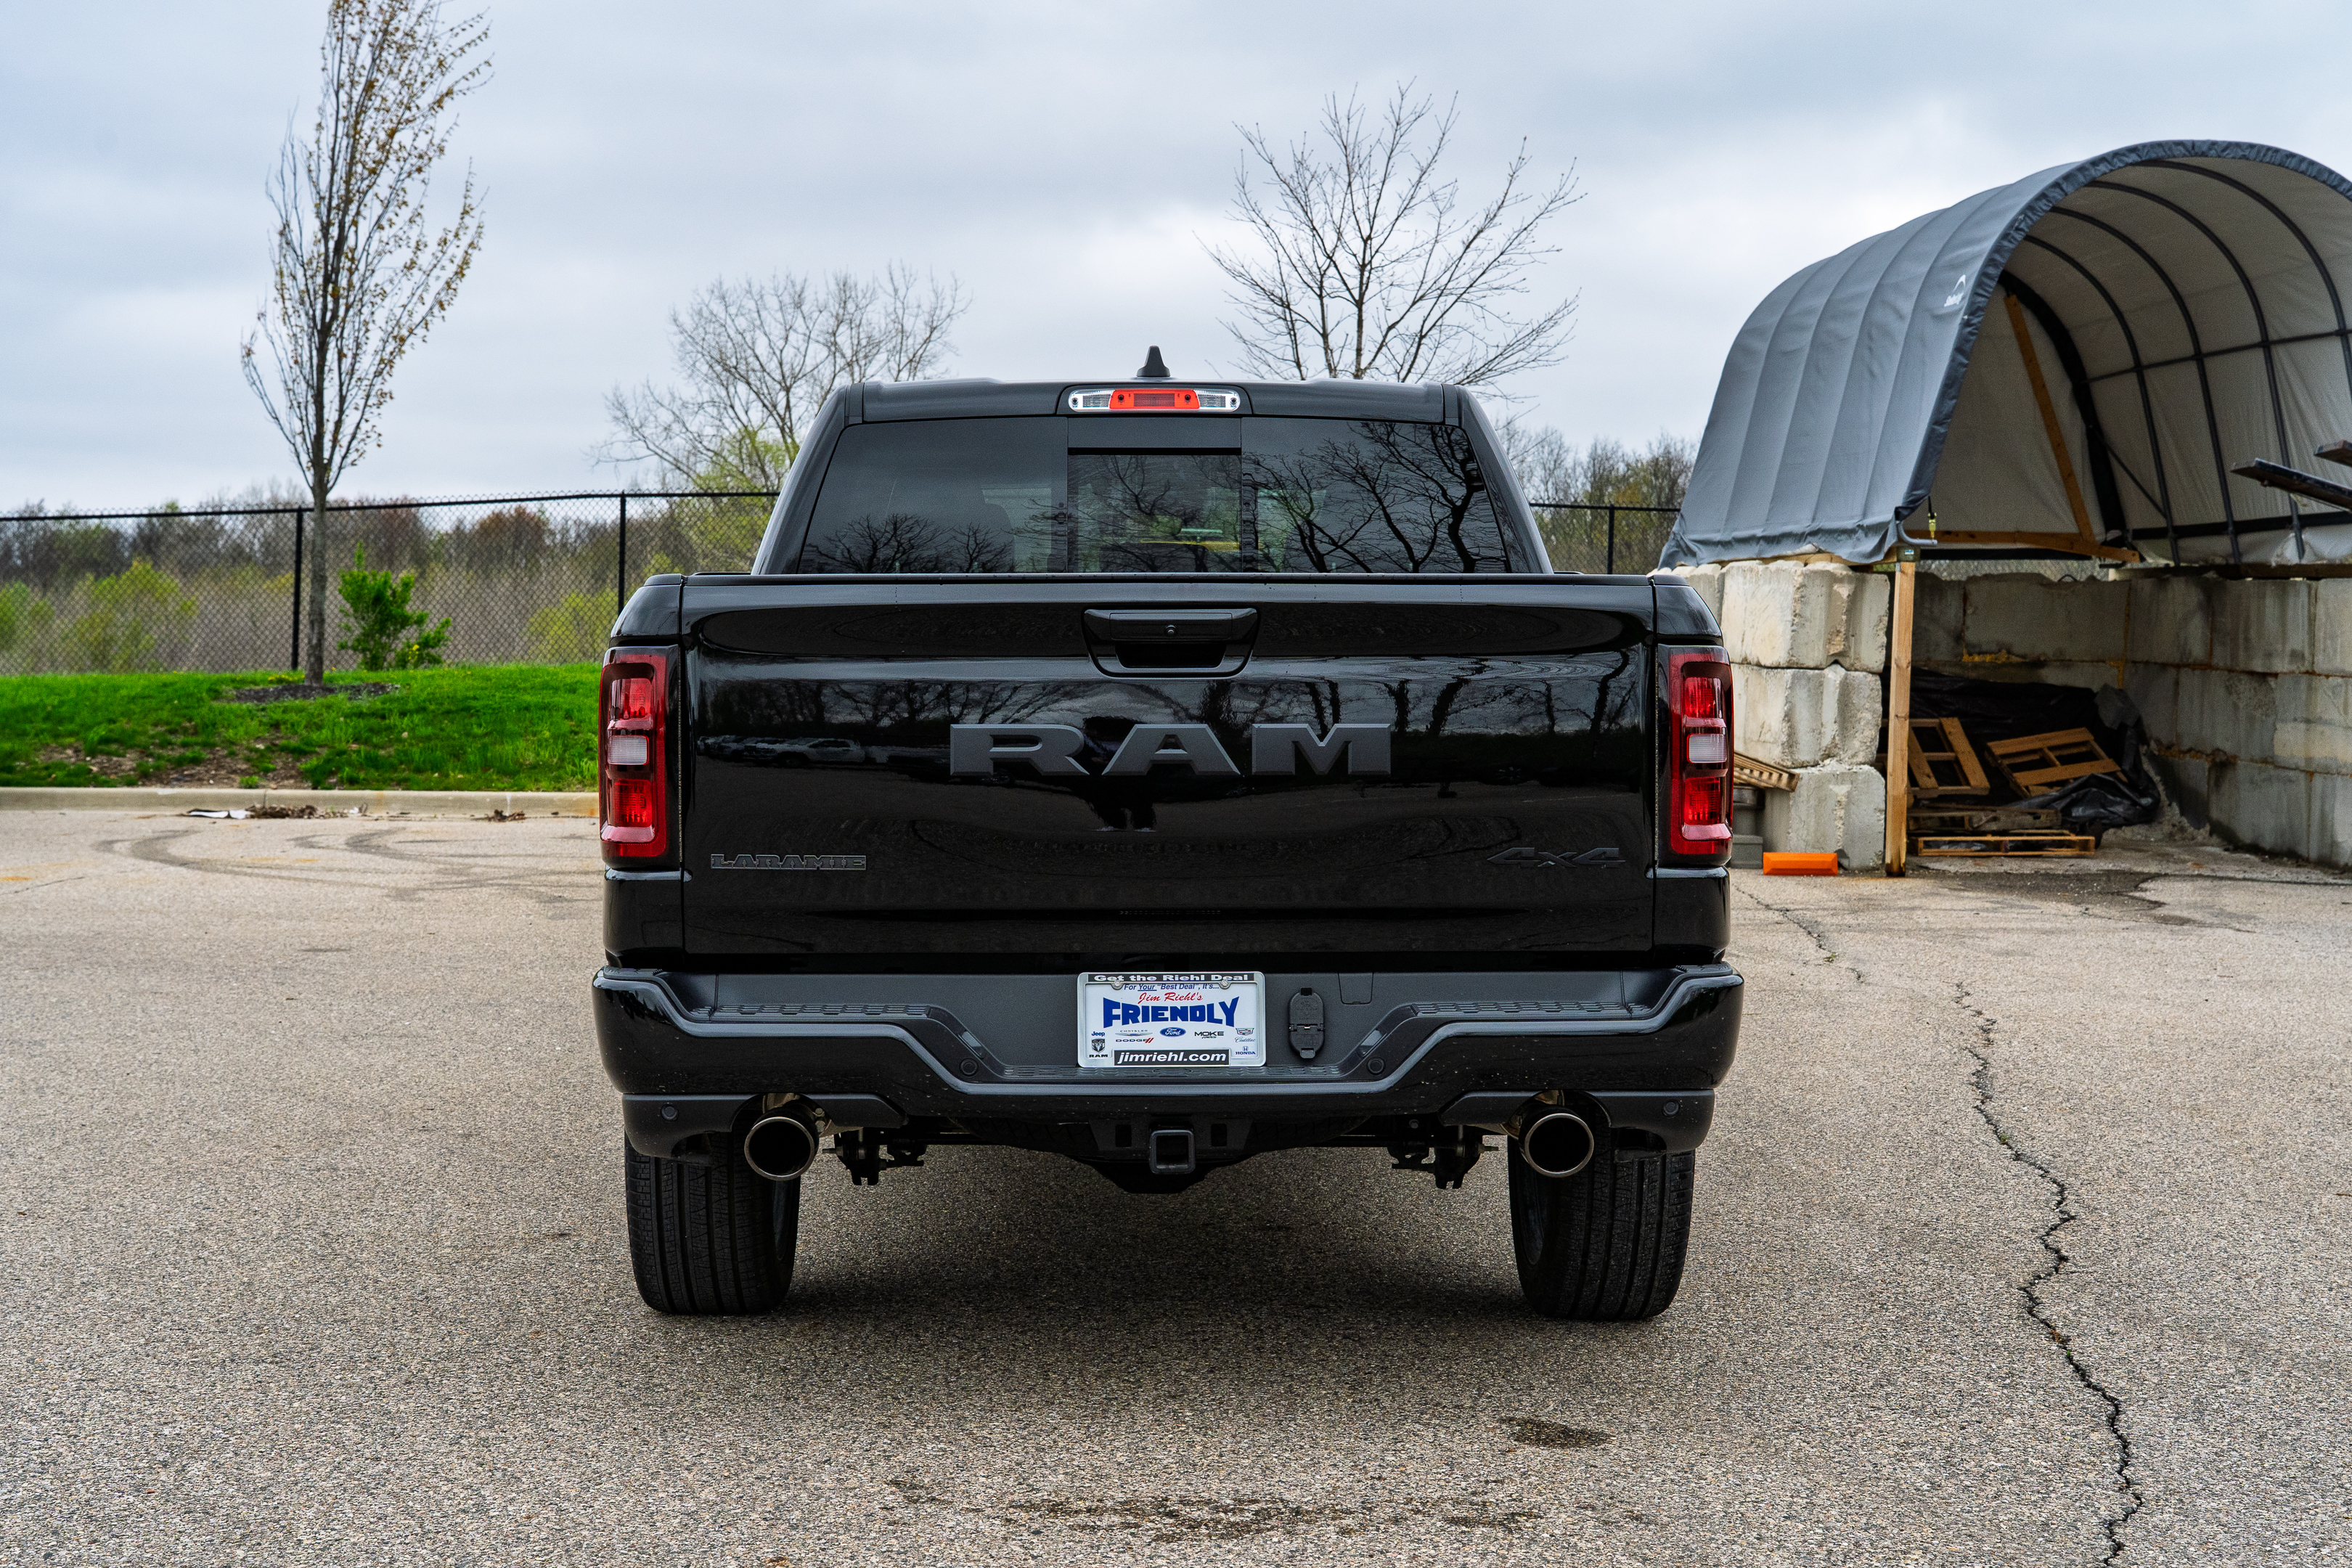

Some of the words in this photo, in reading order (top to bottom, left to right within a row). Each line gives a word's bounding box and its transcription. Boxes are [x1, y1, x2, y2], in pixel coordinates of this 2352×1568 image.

[950, 723, 1391, 775] RAM
[711, 854, 867, 870] LARAMIE
[1138, 992, 1161, 1004] Jim
[1164, 992, 1203, 1002] Riehl's
[1103, 996, 1239, 1028] FRIENDLY
[1117, 1052, 1227, 1064] jimriehl.com
